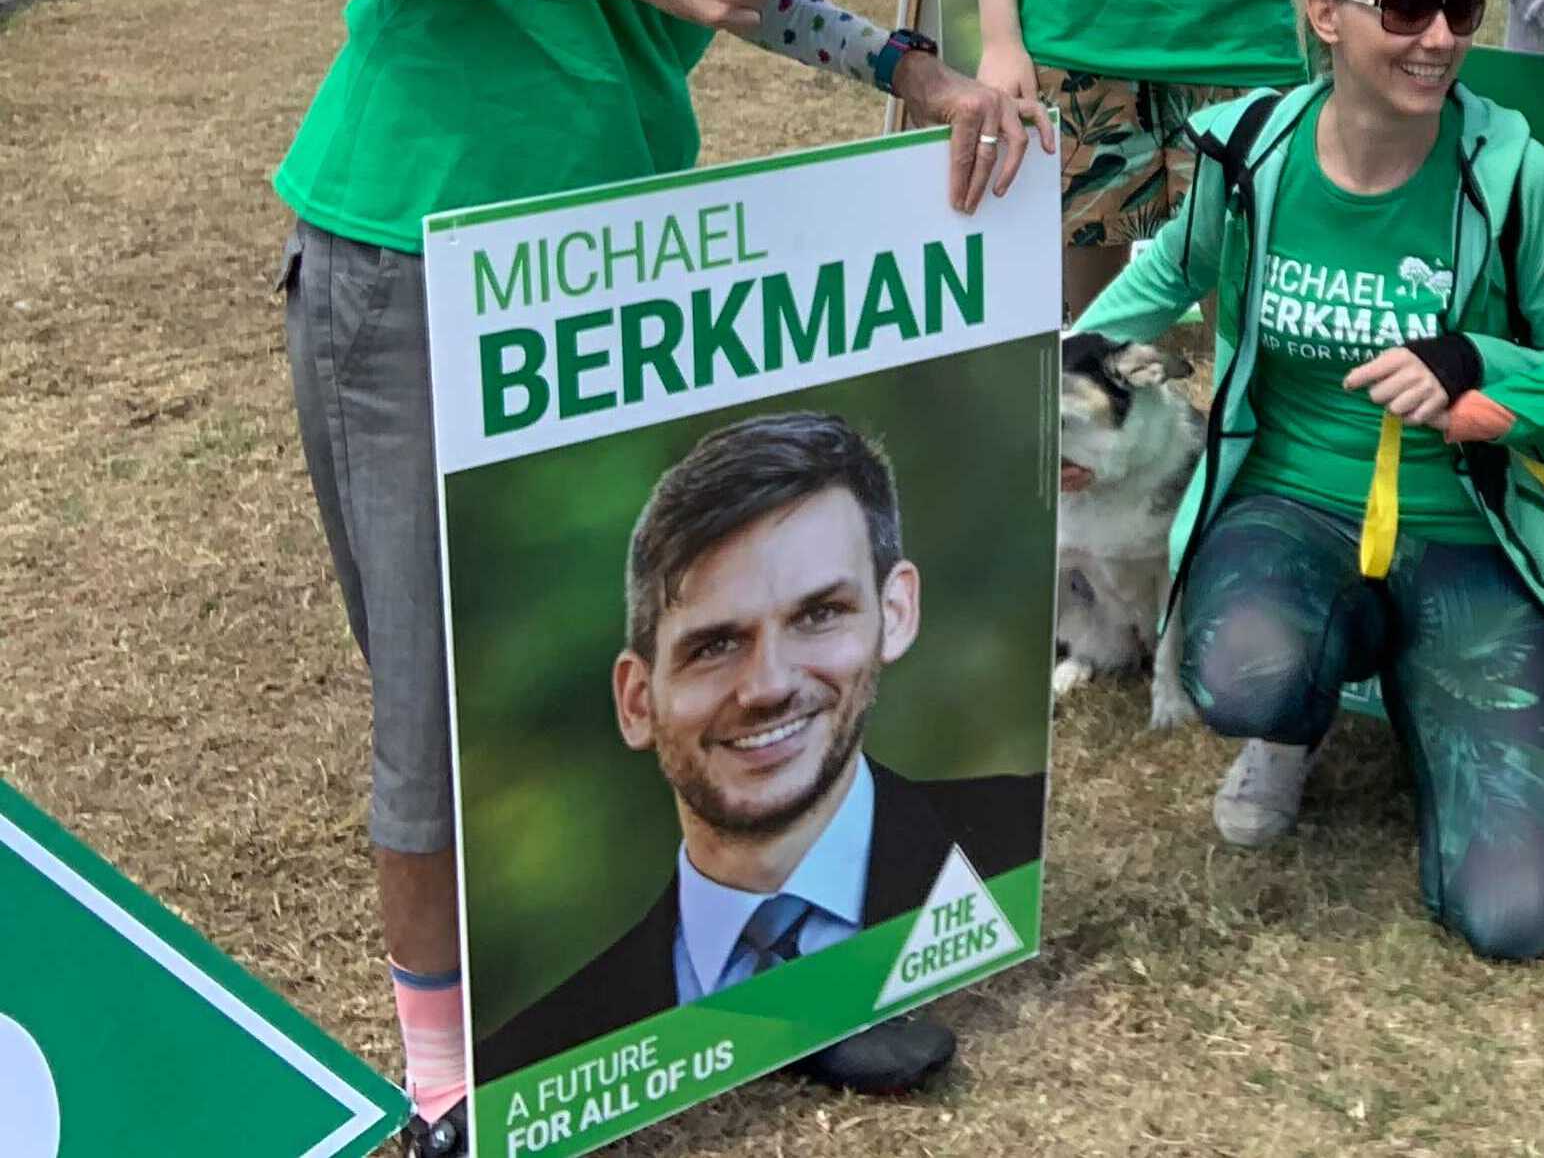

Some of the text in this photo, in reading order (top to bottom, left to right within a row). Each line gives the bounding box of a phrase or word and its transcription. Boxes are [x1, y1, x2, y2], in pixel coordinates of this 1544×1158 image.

[473, 202, 769, 315] MICHAEL
[478, 233, 986, 438] BERKMAN
[1260, 289, 1437, 345] ERKMAN
[1287, 341, 1332, 361] FOR
[900, 918, 998, 984] GREENS
[930, 892, 979, 935] THE
[507, 1035, 658, 1126] A FUTURE
[507, 1040, 734, 1158] FOR ALL OF US
